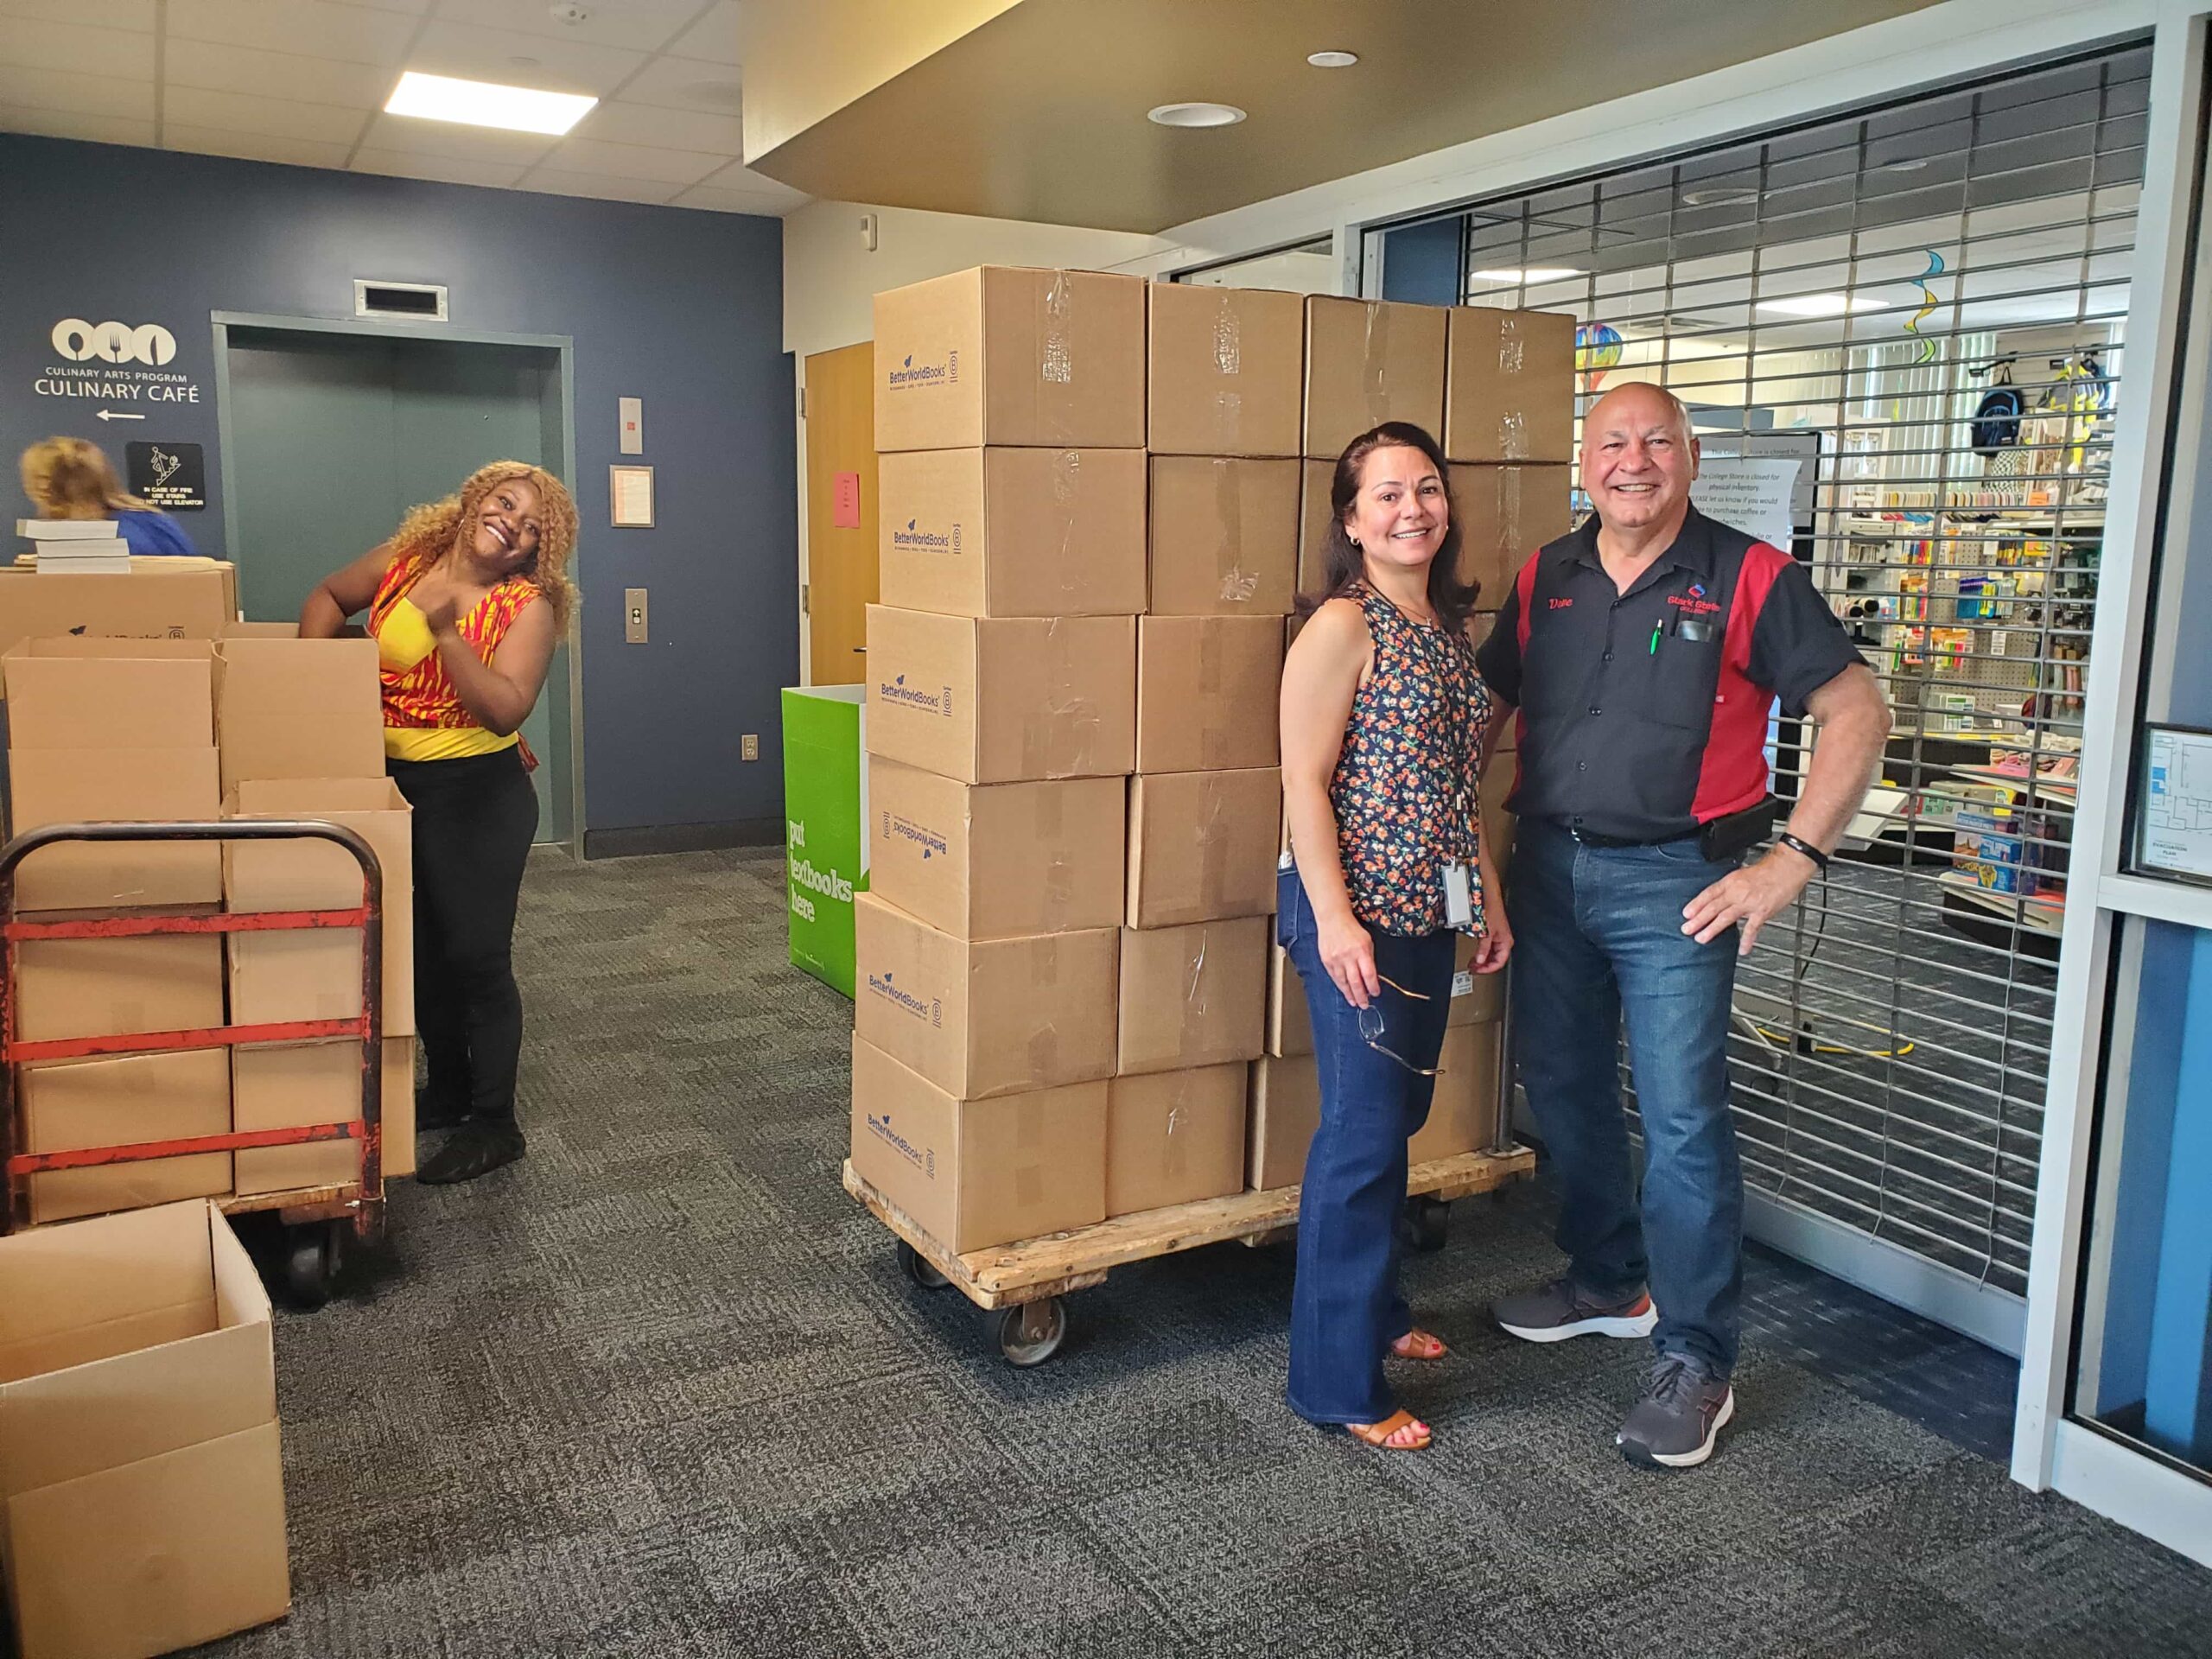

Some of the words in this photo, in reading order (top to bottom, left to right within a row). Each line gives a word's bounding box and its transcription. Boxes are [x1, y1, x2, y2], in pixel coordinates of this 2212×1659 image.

[45, 366, 99, 378] CULINARY
[105, 370, 131, 380] ARTS
[136, 372, 188, 383] PROGRAM
[889, 364, 945, 384] BetterWorldBooks
[35, 379, 141, 400] CULINARY
[148, 385, 200, 403] CAFÉ
[894, 531, 949, 547] BetterWorldBooks
[881, 683, 938, 707] BetterWorldBooks
[789, 820, 805, 850] put
[790, 850, 853, 903] textbooks
[869, 974, 928, 1015] BetterWorldBooks
[868, 1113, 922, 1164] BetterWorldBooks
